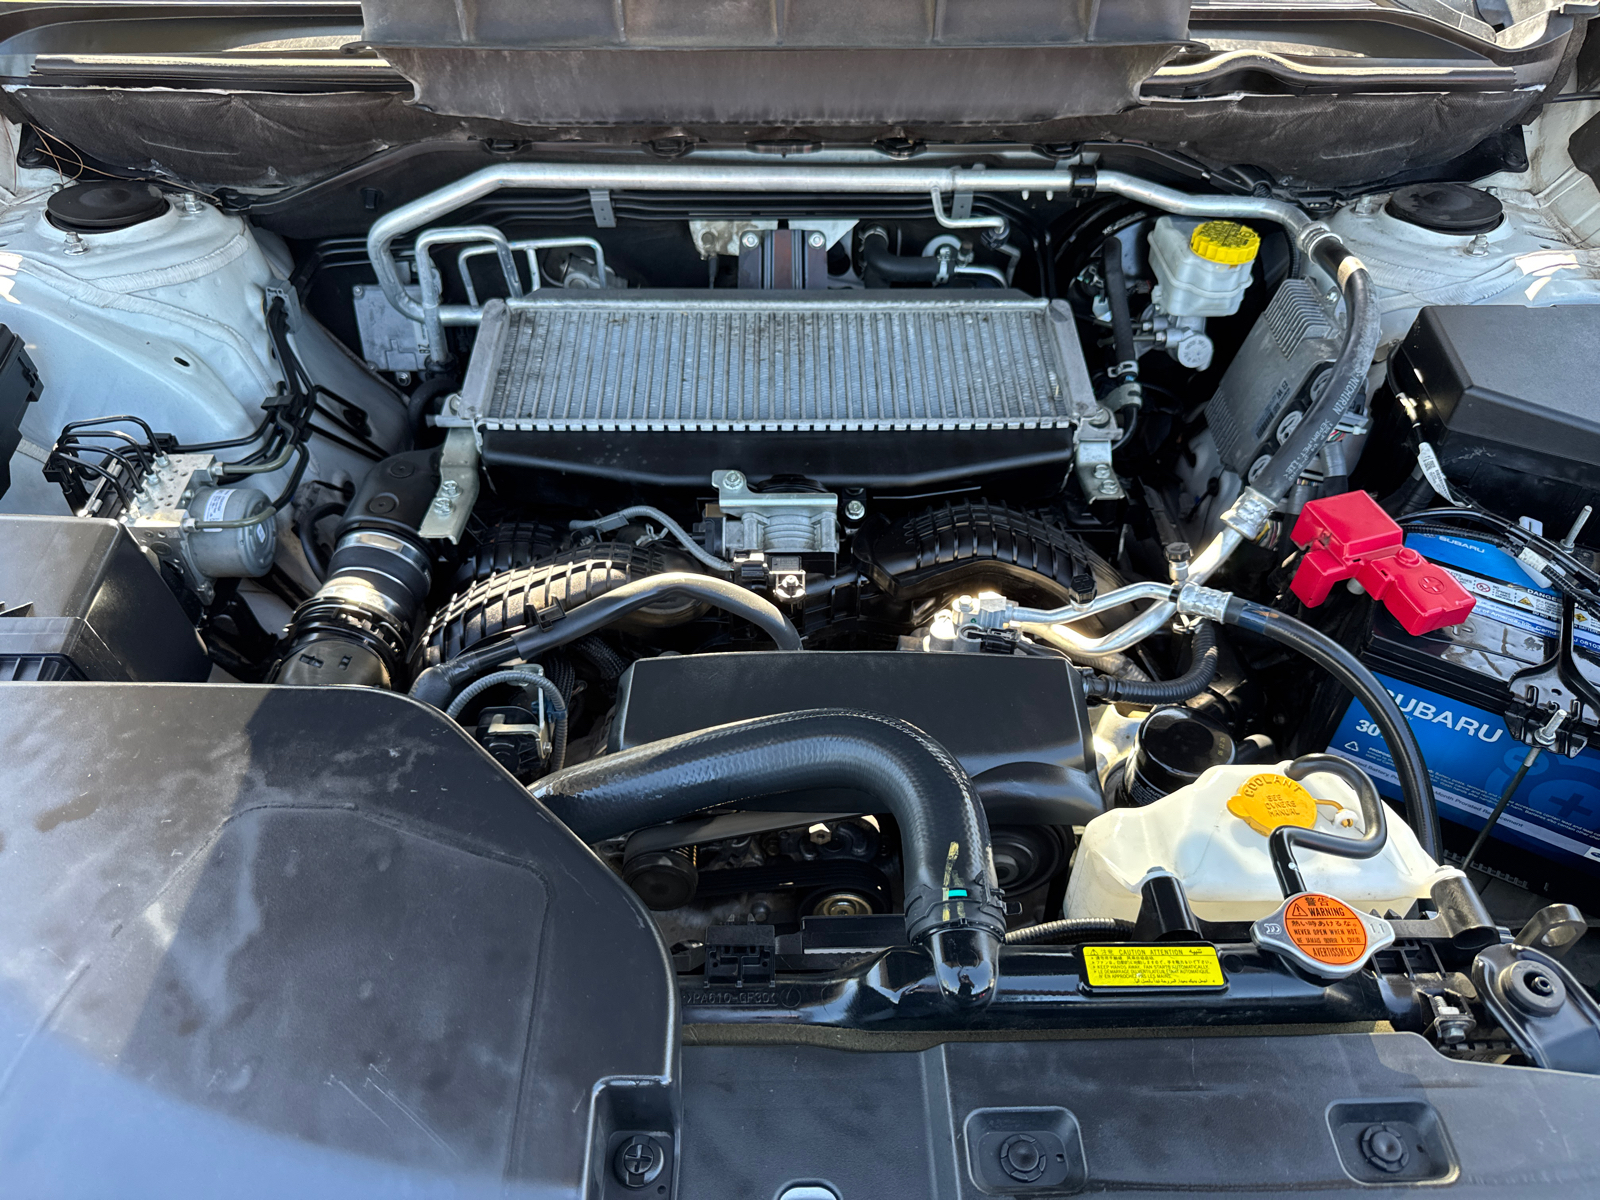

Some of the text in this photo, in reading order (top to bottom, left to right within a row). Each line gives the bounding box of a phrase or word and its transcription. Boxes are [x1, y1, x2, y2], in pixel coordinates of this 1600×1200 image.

[1438, 536, 1485, 554] SUBARU
[1386, 688, 1503, 743] UBARU
[1244, 775, 1301, 798] COOLANT
[1266, 794, 1282, 802] SEE
[1268, 809, 1300, 817] MANUAL
[1308, 907, 1345, 917] WARNING
